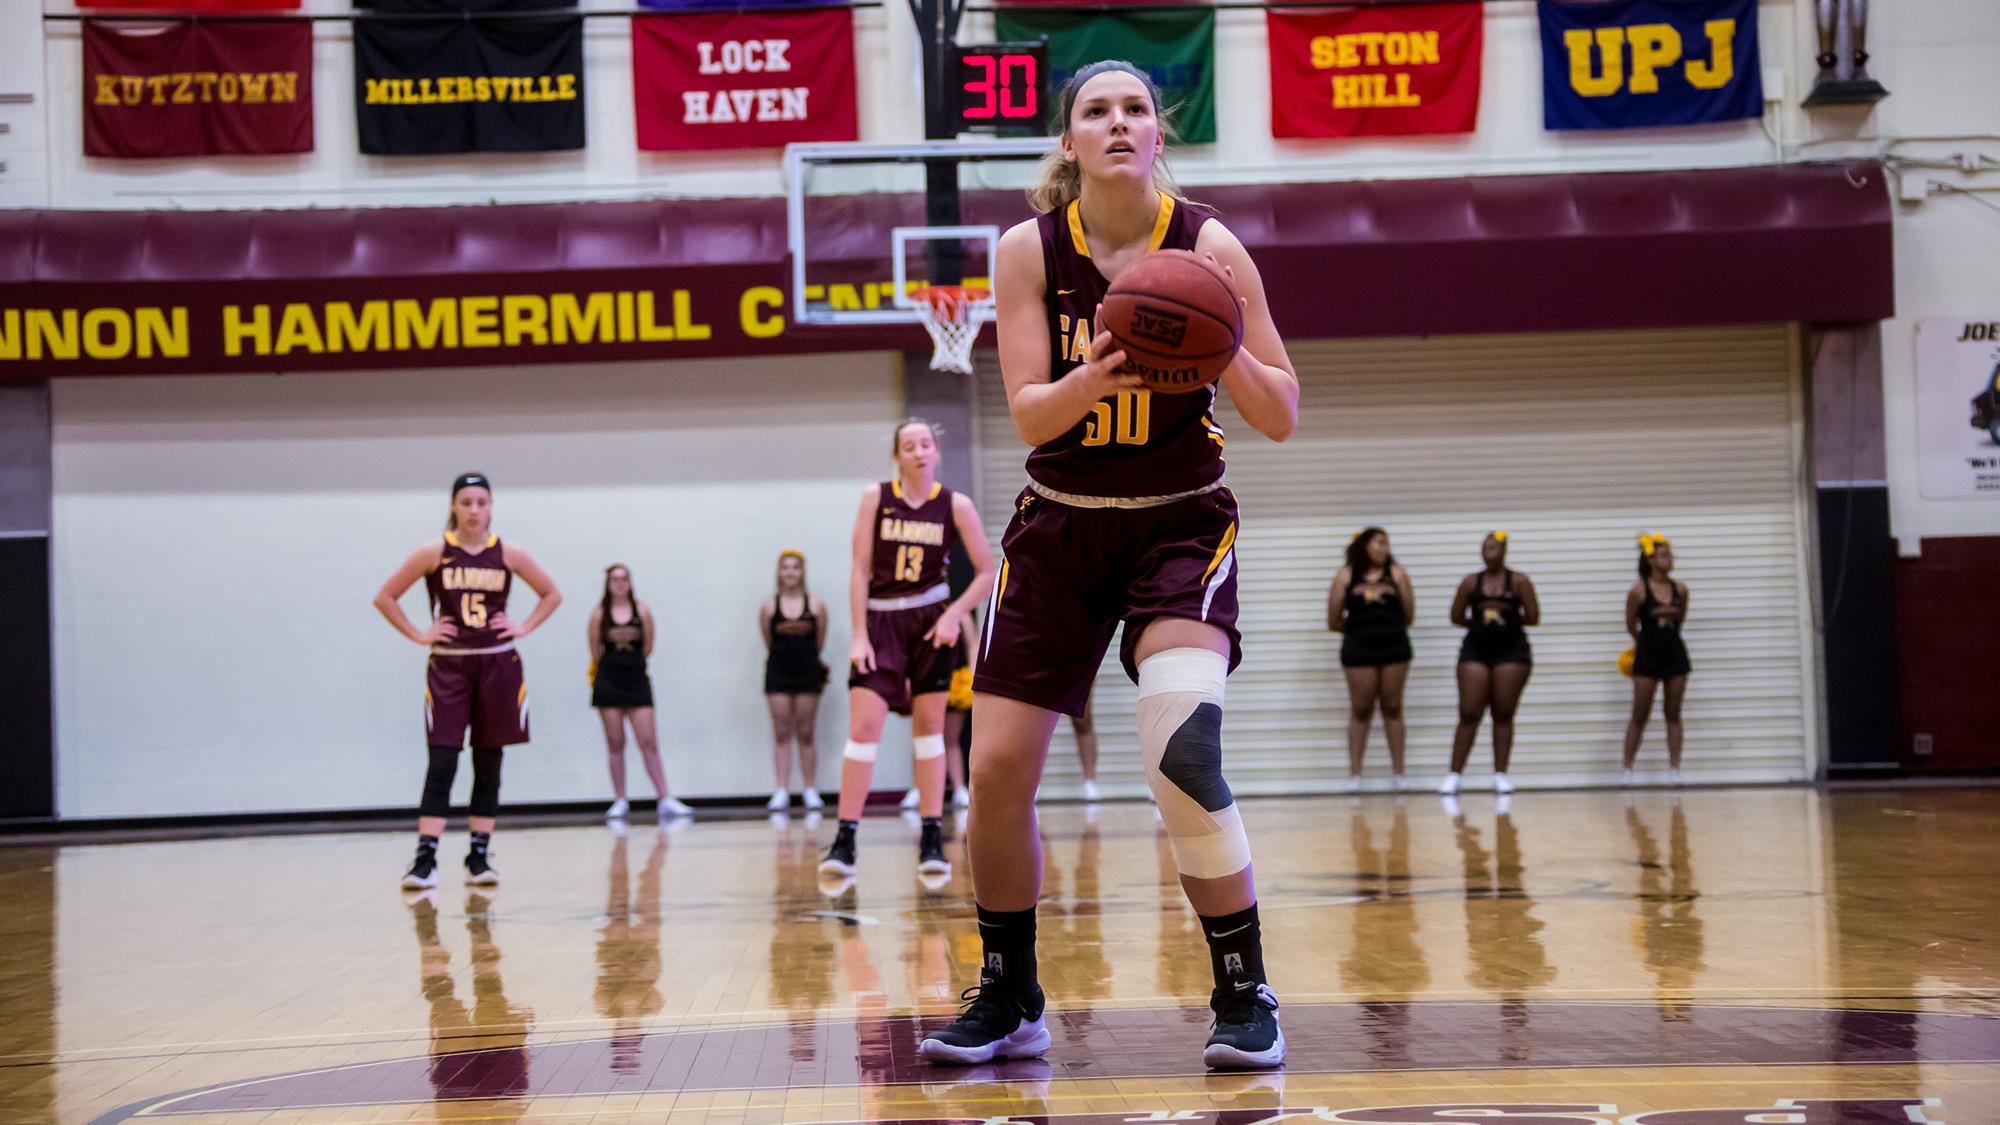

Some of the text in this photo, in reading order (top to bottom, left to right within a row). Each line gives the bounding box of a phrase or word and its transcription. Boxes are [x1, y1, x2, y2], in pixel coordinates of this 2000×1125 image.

[697, 39, 791, 74] LOCK
[1310, 31, 1440, 69] SETON
[1563, 18, 1736, 97] UPJ
[95, 72, 298, 106] KUTZTOWN
[365, 74, 577, 104] MILLERSVILLE
[962, 54, 1037, 118] 30
[1331, 73, 1422, 109] HILL
[682, 87, 810, 124] HAVEN
[223, 290, 711, 356] HAMMERMILL
[1131, 312, 1188, 342] PSAC
[895, 545, 924, 582] 13
[461, 592, 487, 628] 15
